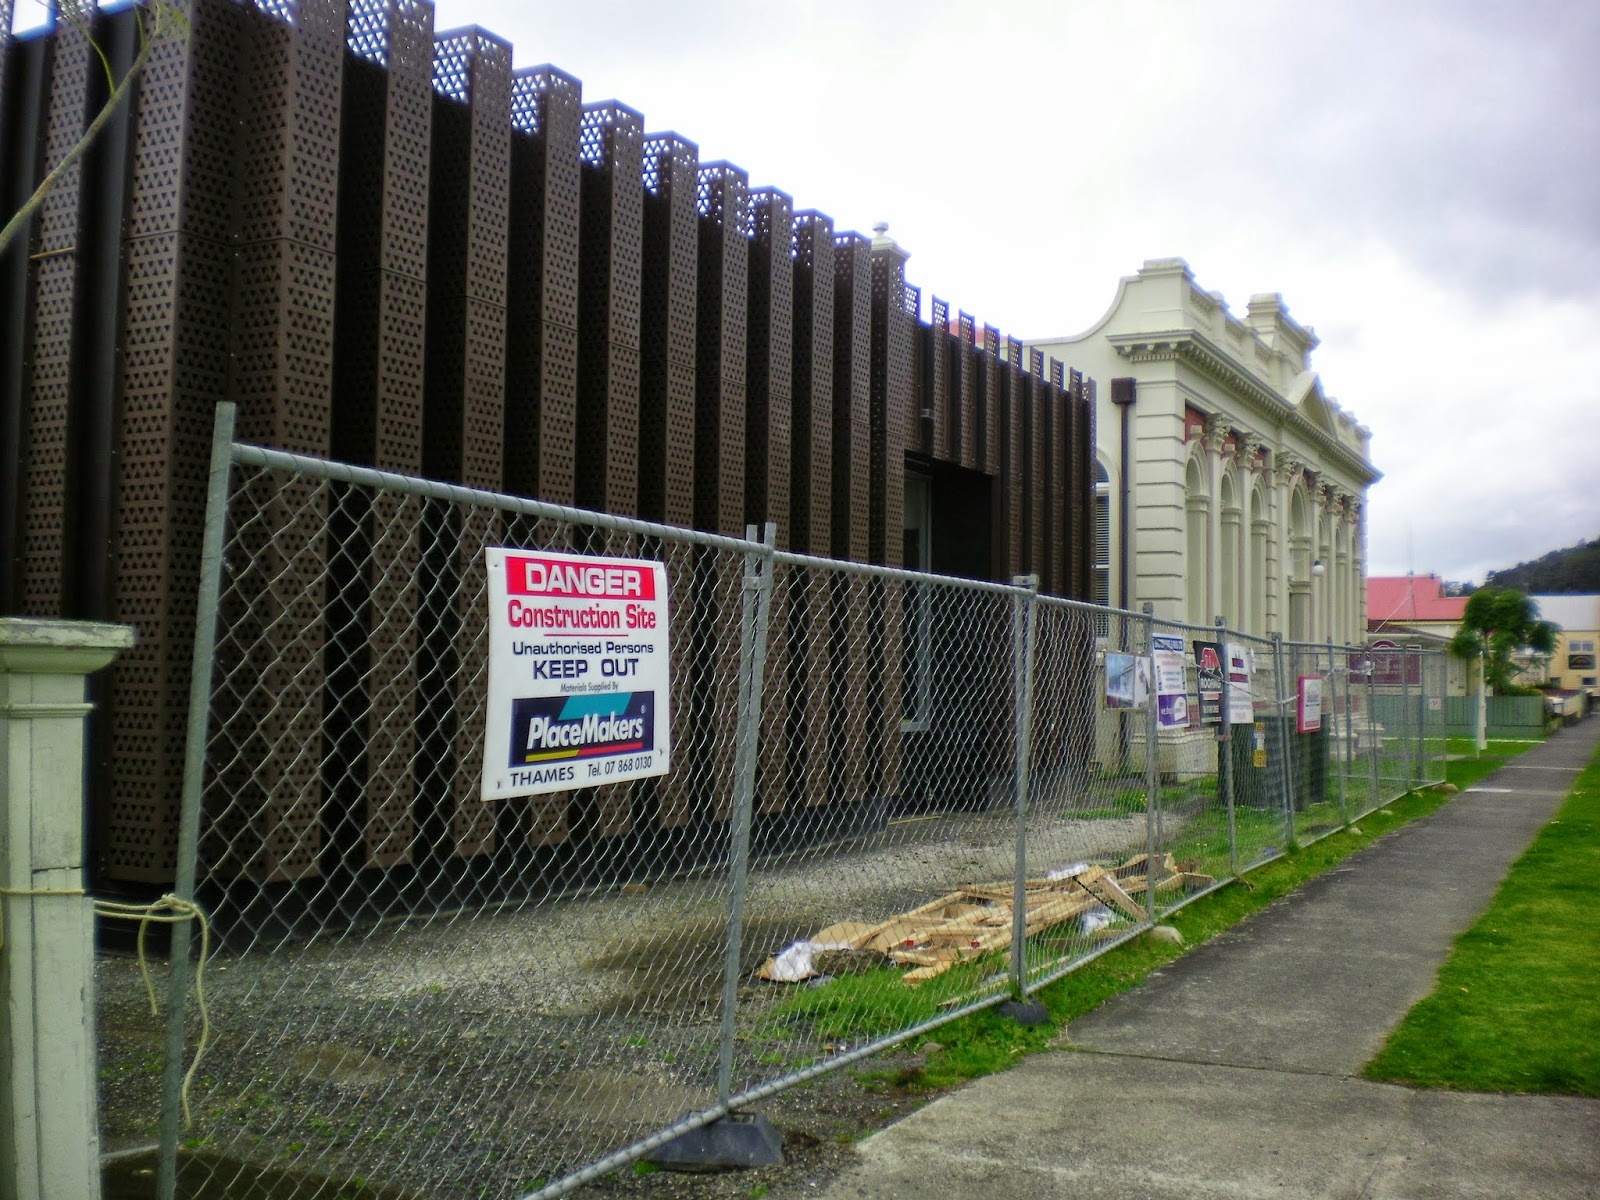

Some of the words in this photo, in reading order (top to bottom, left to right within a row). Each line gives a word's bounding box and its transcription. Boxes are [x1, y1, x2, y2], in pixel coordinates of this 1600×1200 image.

[525, 562, 641, 597] DANGER
[507, 599, 620, 629] Construction
[626, 603, 656, 629] Site
[512, 641, 601, 655] Unauthorised
[606, 641, 654, 654] Persons
[533, 659, 588, 680] KEEP
[601, 658, 639, 677] OUT
[560, 683, 587, 693] Materials
[588, 682, 611, 693] Supplied
[612, 682, 619, 692] By
[527, 711, 643, 750] PlaceMakers
[510, 766, 574, 787] THAMES
[587, 763, 602, 778] Tel.
[604, 761, 615, 775] 07
[617, 759, 633, 773] 868
[634, 756, 652, 770] 0130
